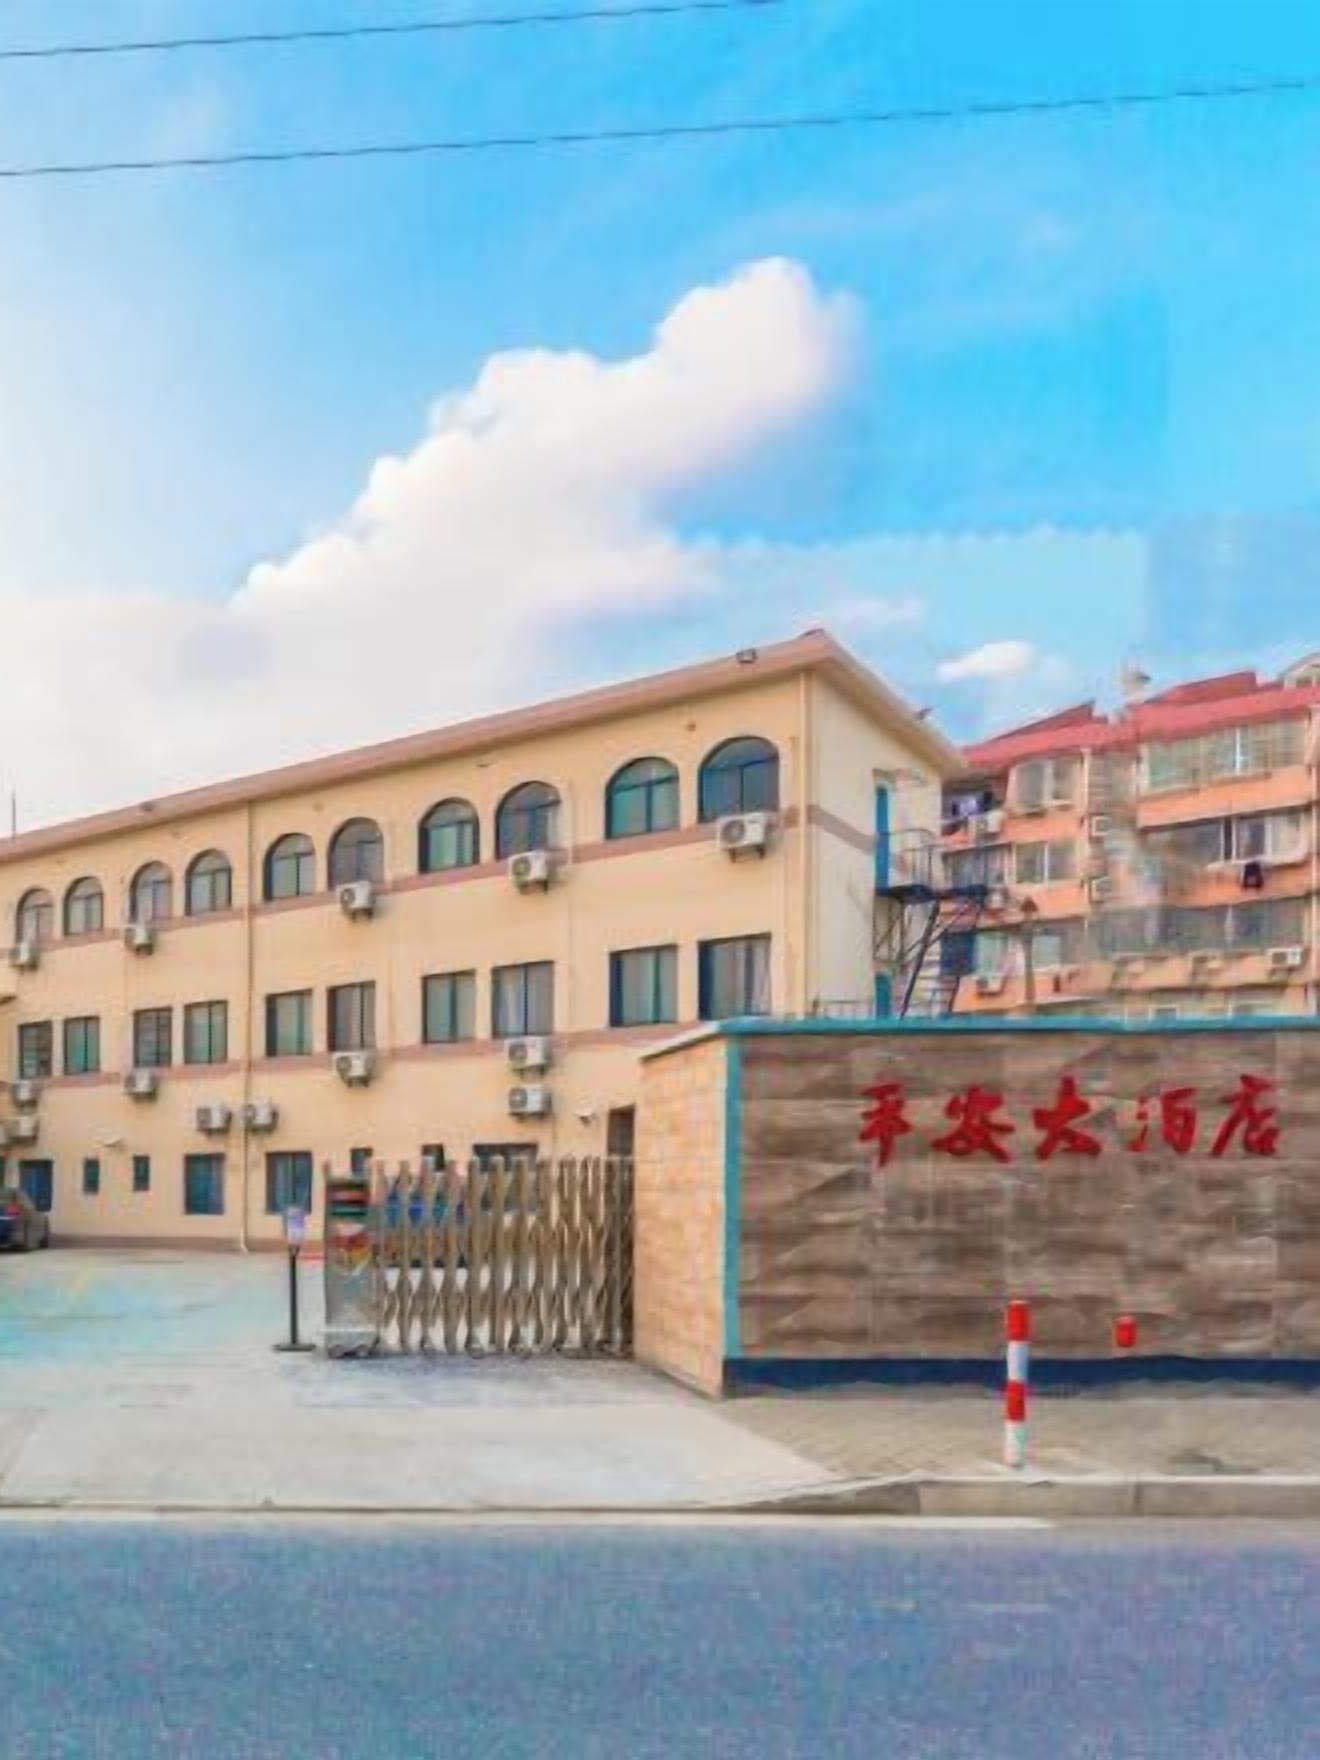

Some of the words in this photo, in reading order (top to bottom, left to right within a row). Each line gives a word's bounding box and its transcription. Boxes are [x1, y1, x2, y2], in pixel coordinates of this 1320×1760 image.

[857, 1073, 1281, 1169] 平安大酒店
